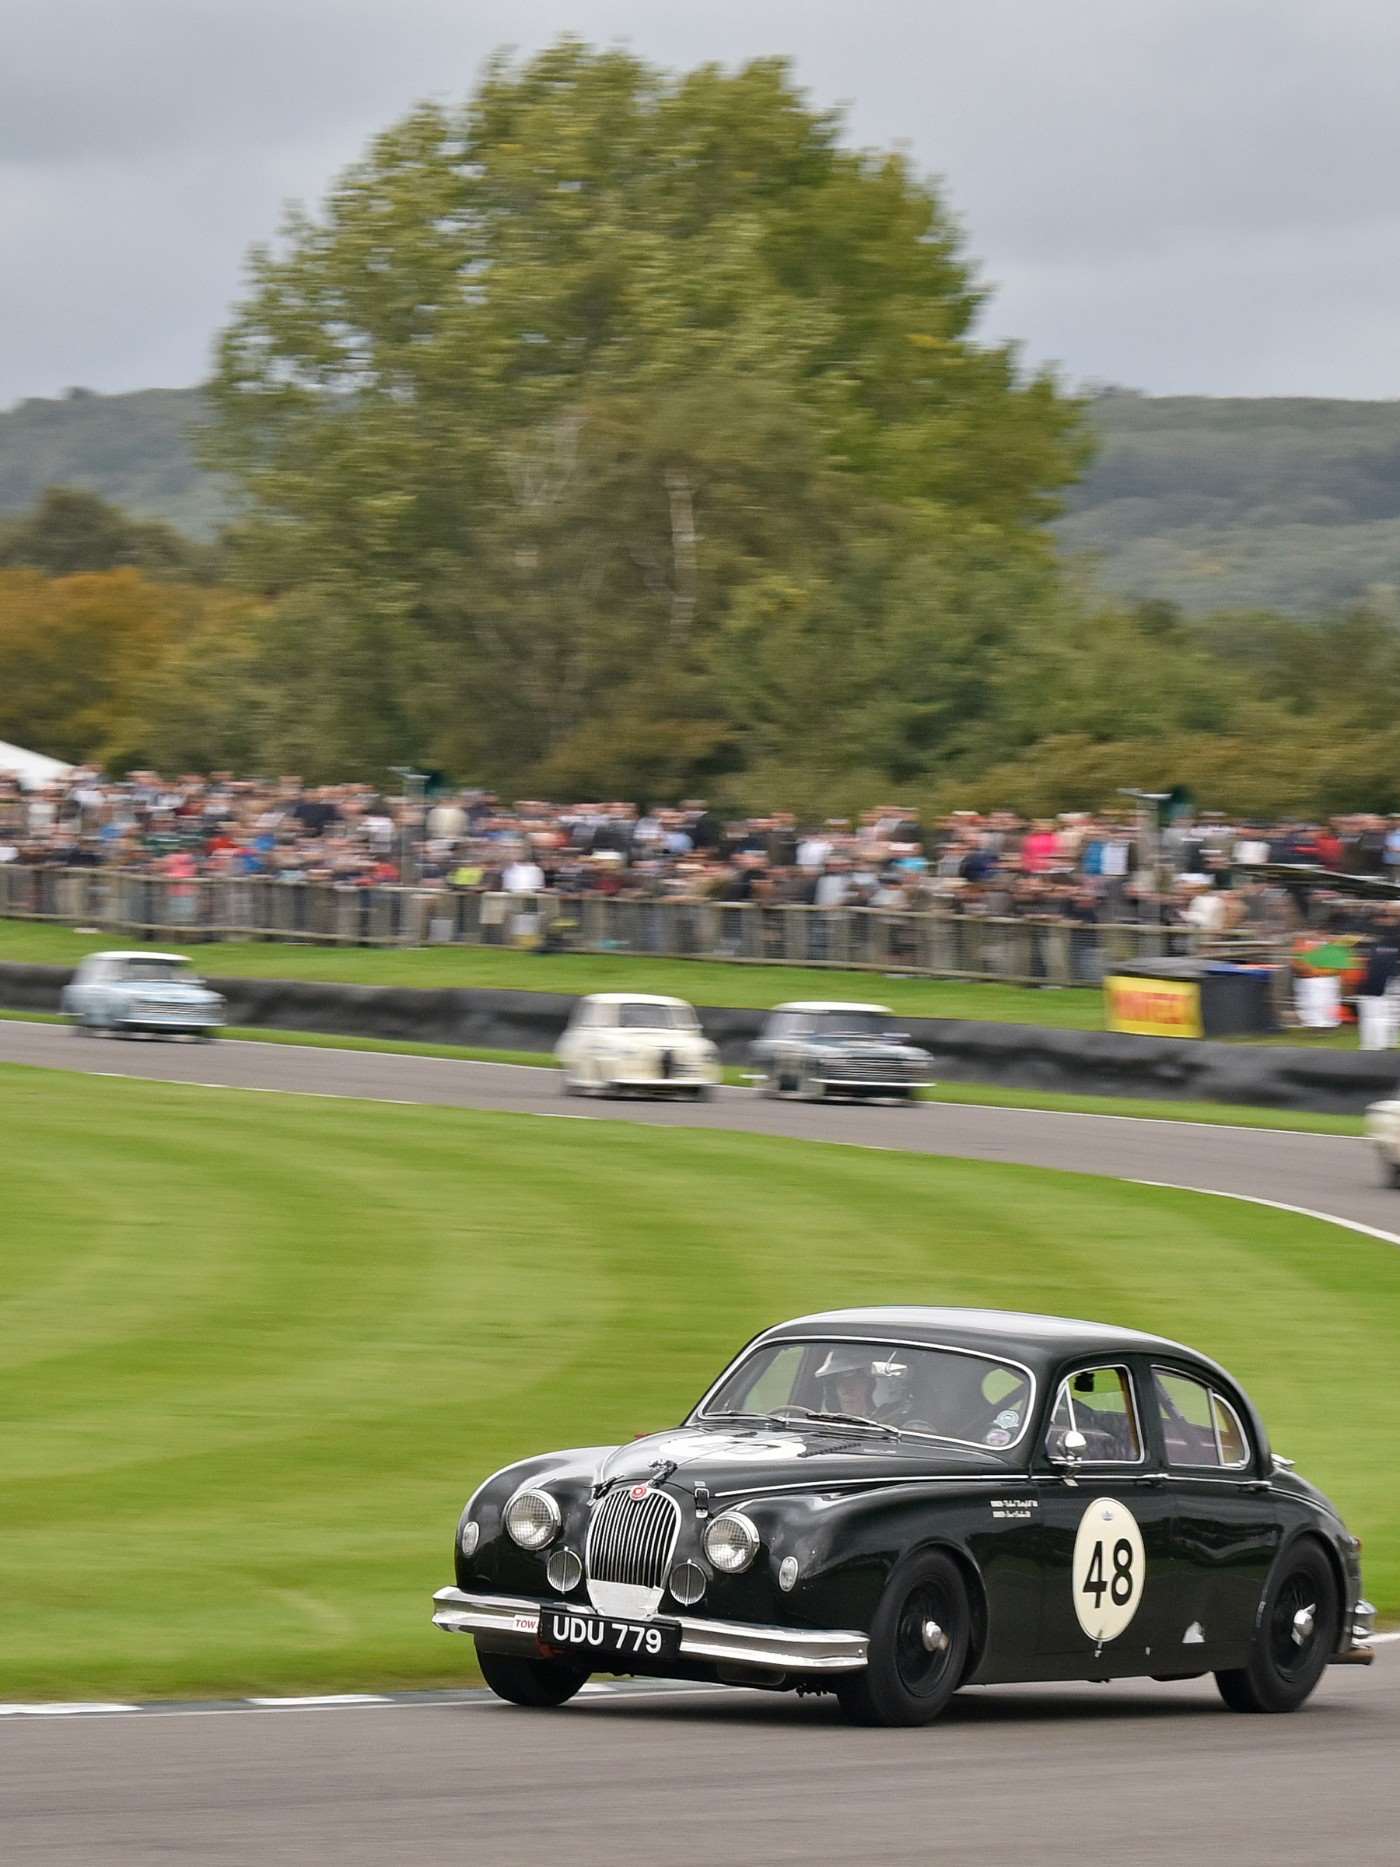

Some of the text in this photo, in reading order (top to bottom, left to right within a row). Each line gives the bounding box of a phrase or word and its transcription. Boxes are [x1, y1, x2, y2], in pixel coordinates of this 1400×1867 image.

[1083, 1538, 1133, 1608] 48
[515, 1619, 537, 1629] TOW
[553, 1615, 662, 1654] UDU 779
